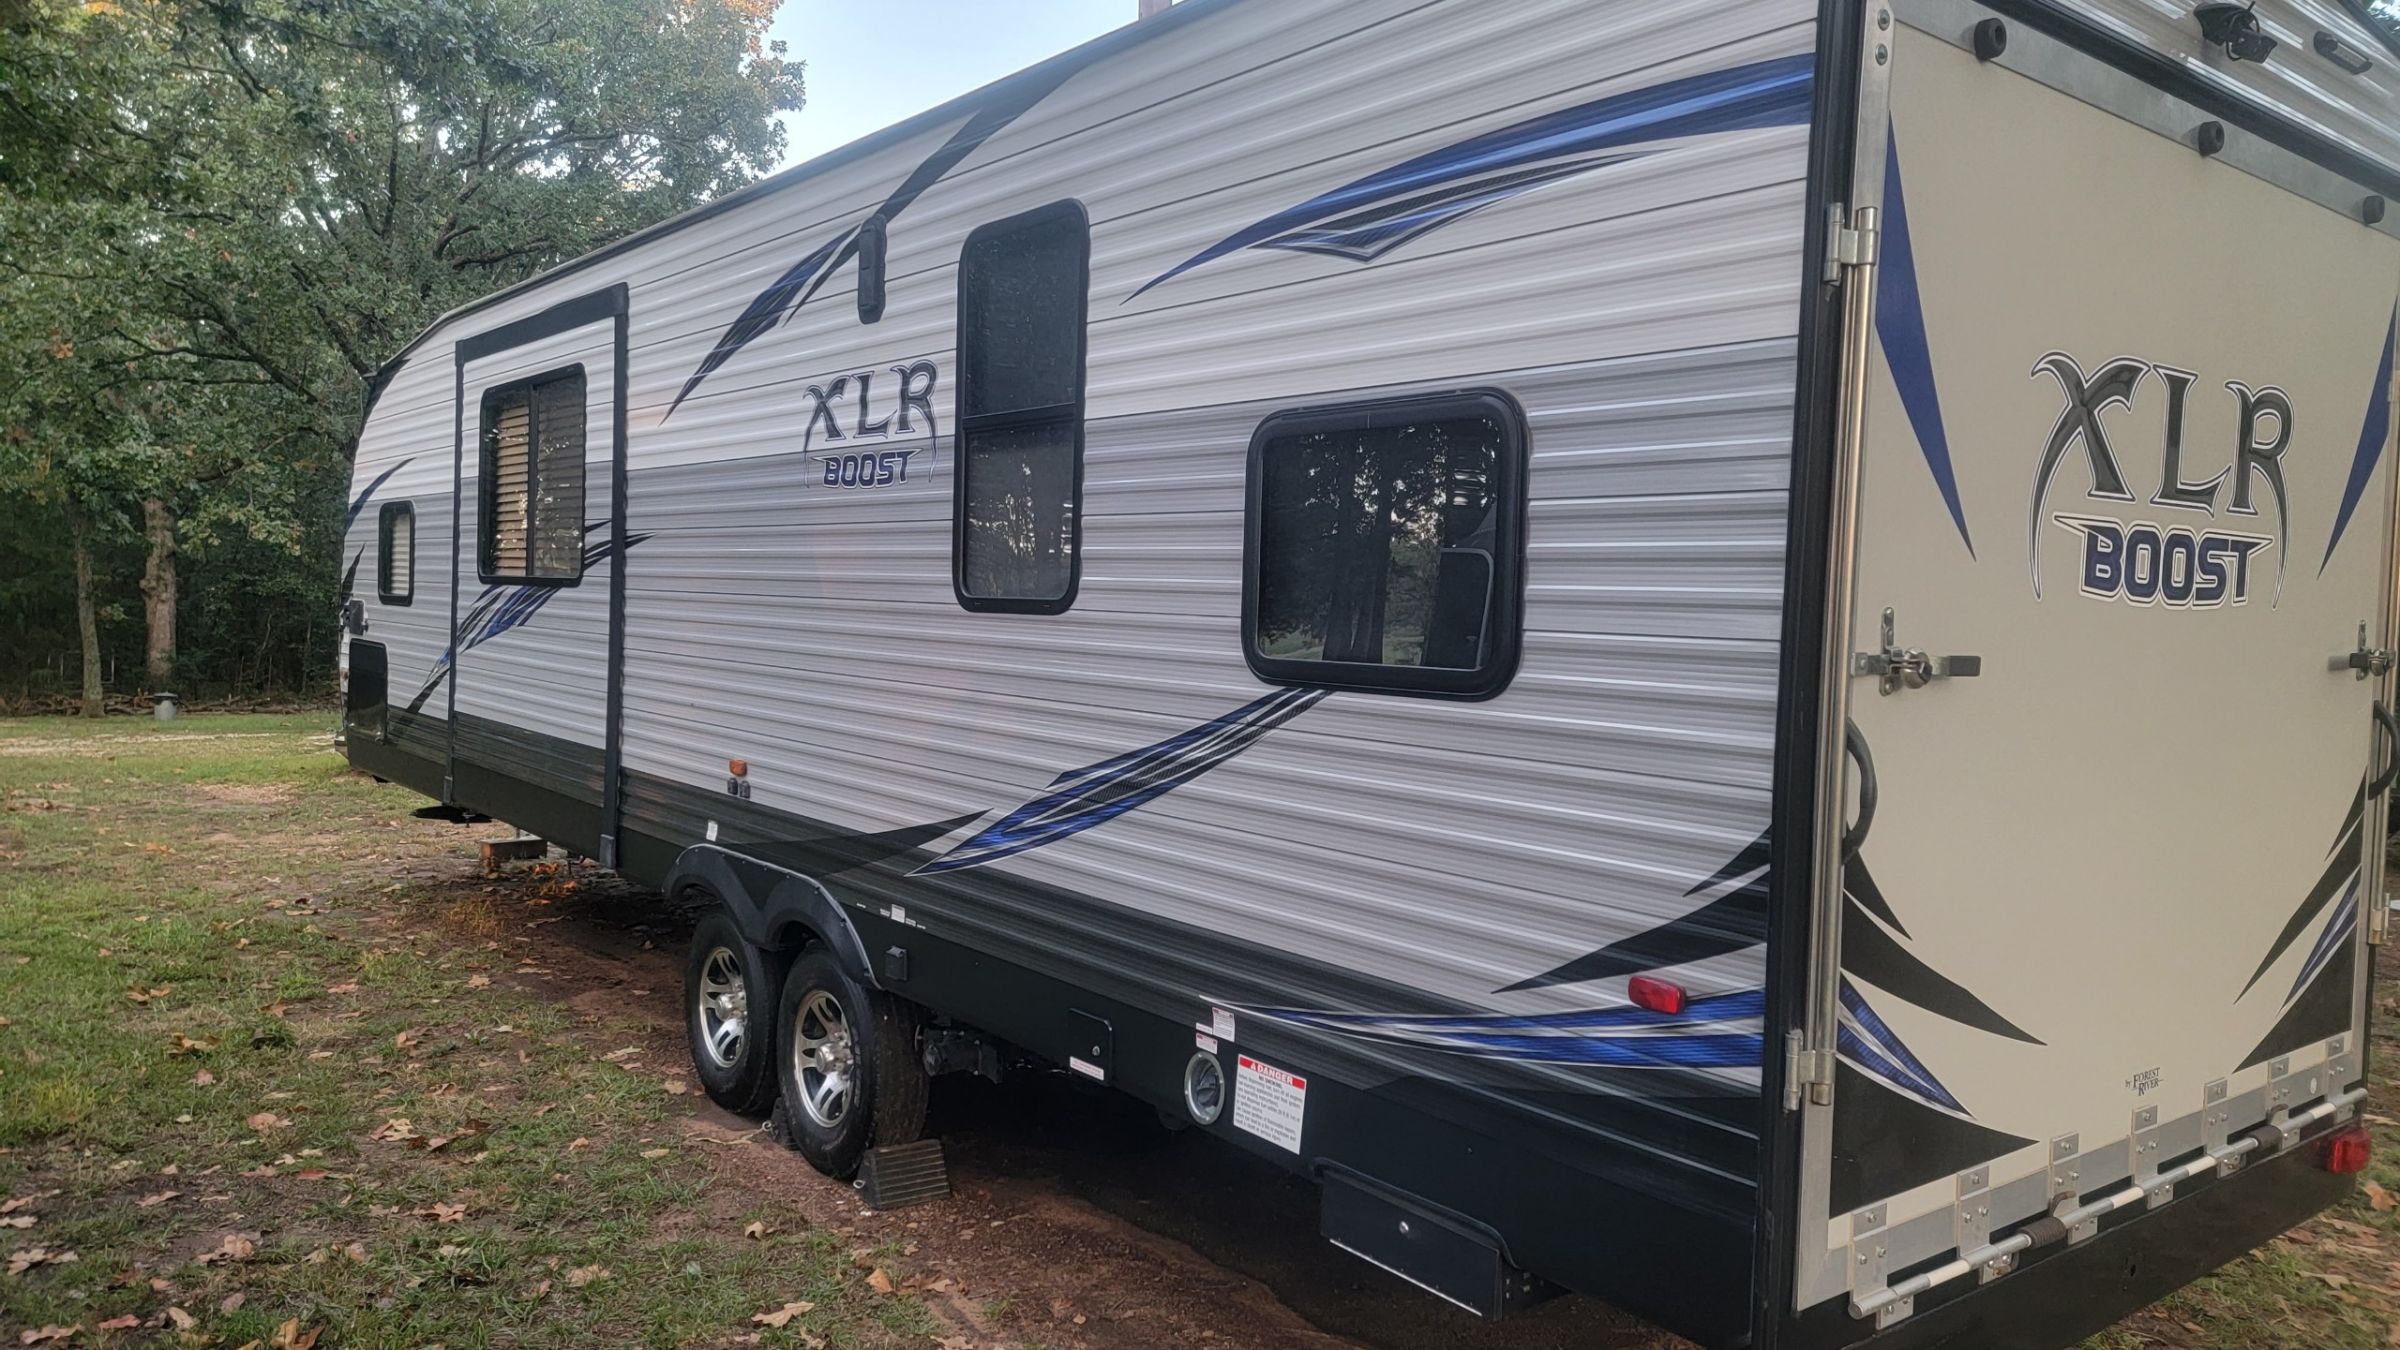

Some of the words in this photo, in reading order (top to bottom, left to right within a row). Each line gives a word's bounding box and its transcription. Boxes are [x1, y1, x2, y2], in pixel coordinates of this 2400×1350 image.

[802, 359, 938, 488] XLR
[810, 448, 923, 489] BOOST
[2029, 350, 2294, 610] XLR
[2052, 510, 2274, 611] BOOST
[1257, 1065, 1293, 1084] DANGER
[2133, 1067, 2160, 1088] FOREST
[2138, 1078, 2159, 1096] RIVER
